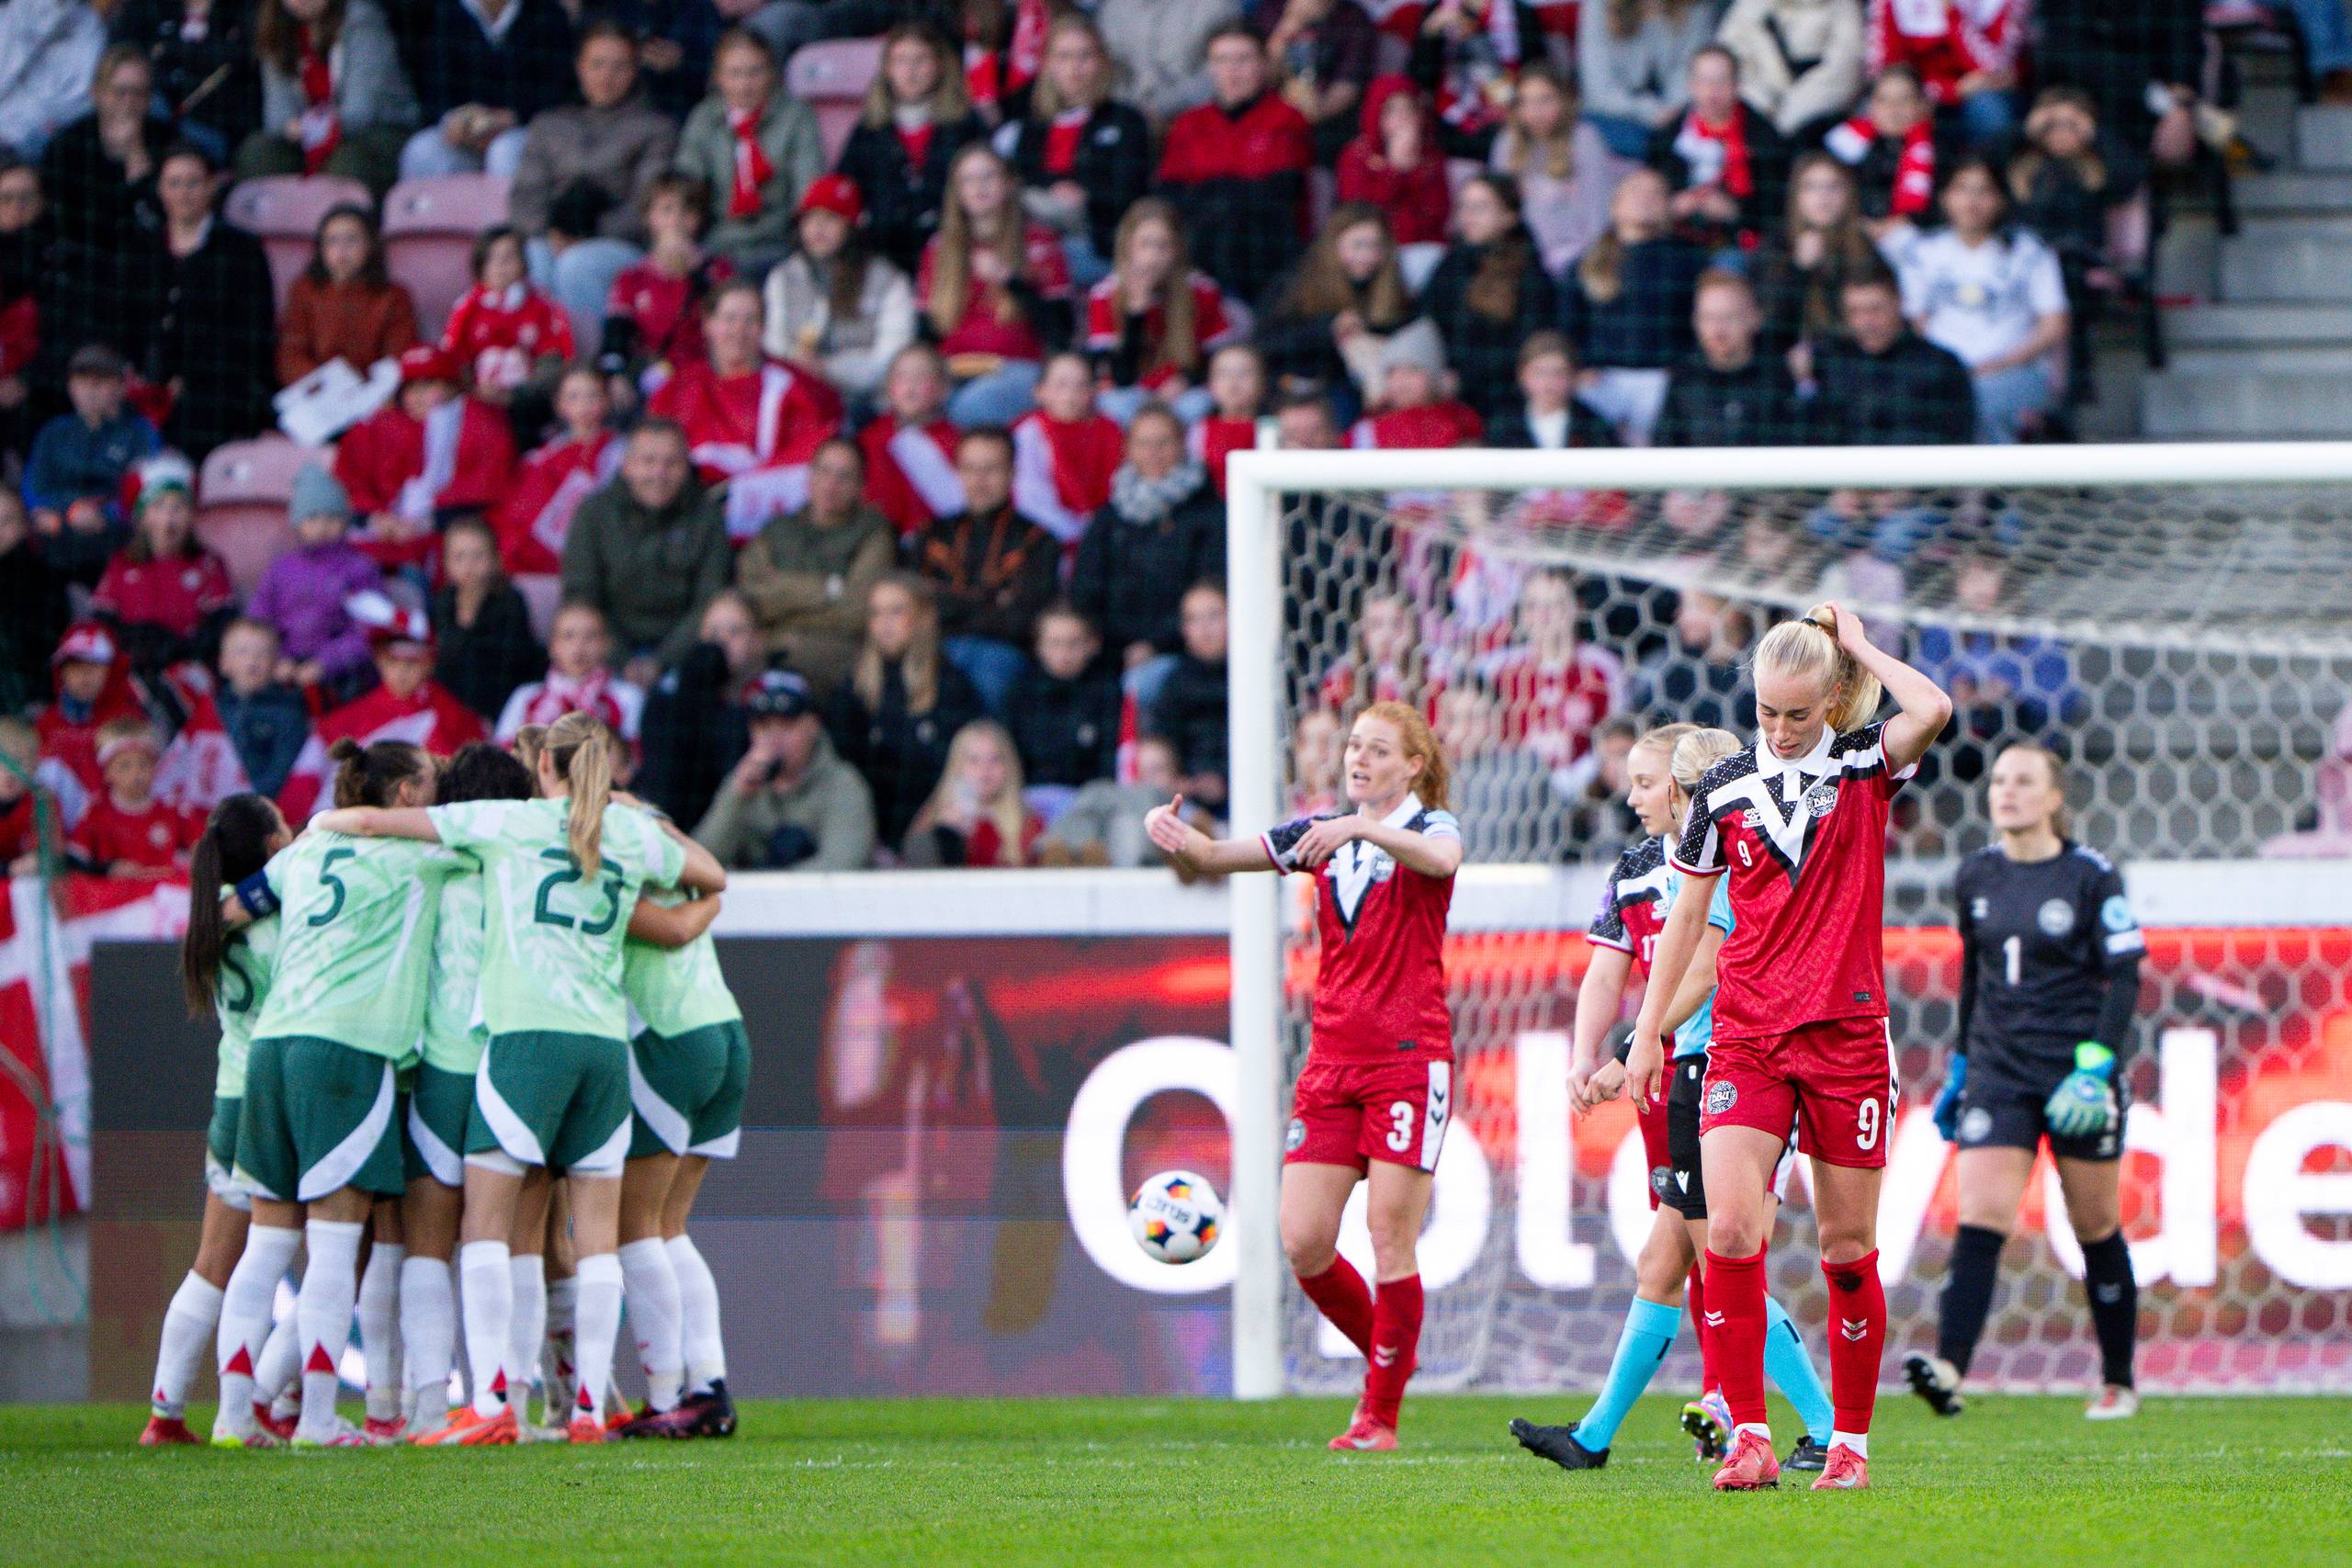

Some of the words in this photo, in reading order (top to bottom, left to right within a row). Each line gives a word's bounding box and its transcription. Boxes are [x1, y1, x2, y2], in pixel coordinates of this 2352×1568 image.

[1813, 795, 1834, 808] DBU
[1737, 840, 1752, 867] 9
[308, 848, 356, 927] 5
[535, 848, 626, 935] 23
[2003, 936, 2020, 986] 1
[1385, 1100, 1416, 1153] 3
[1856, 1097, 1880, 1151] 9
